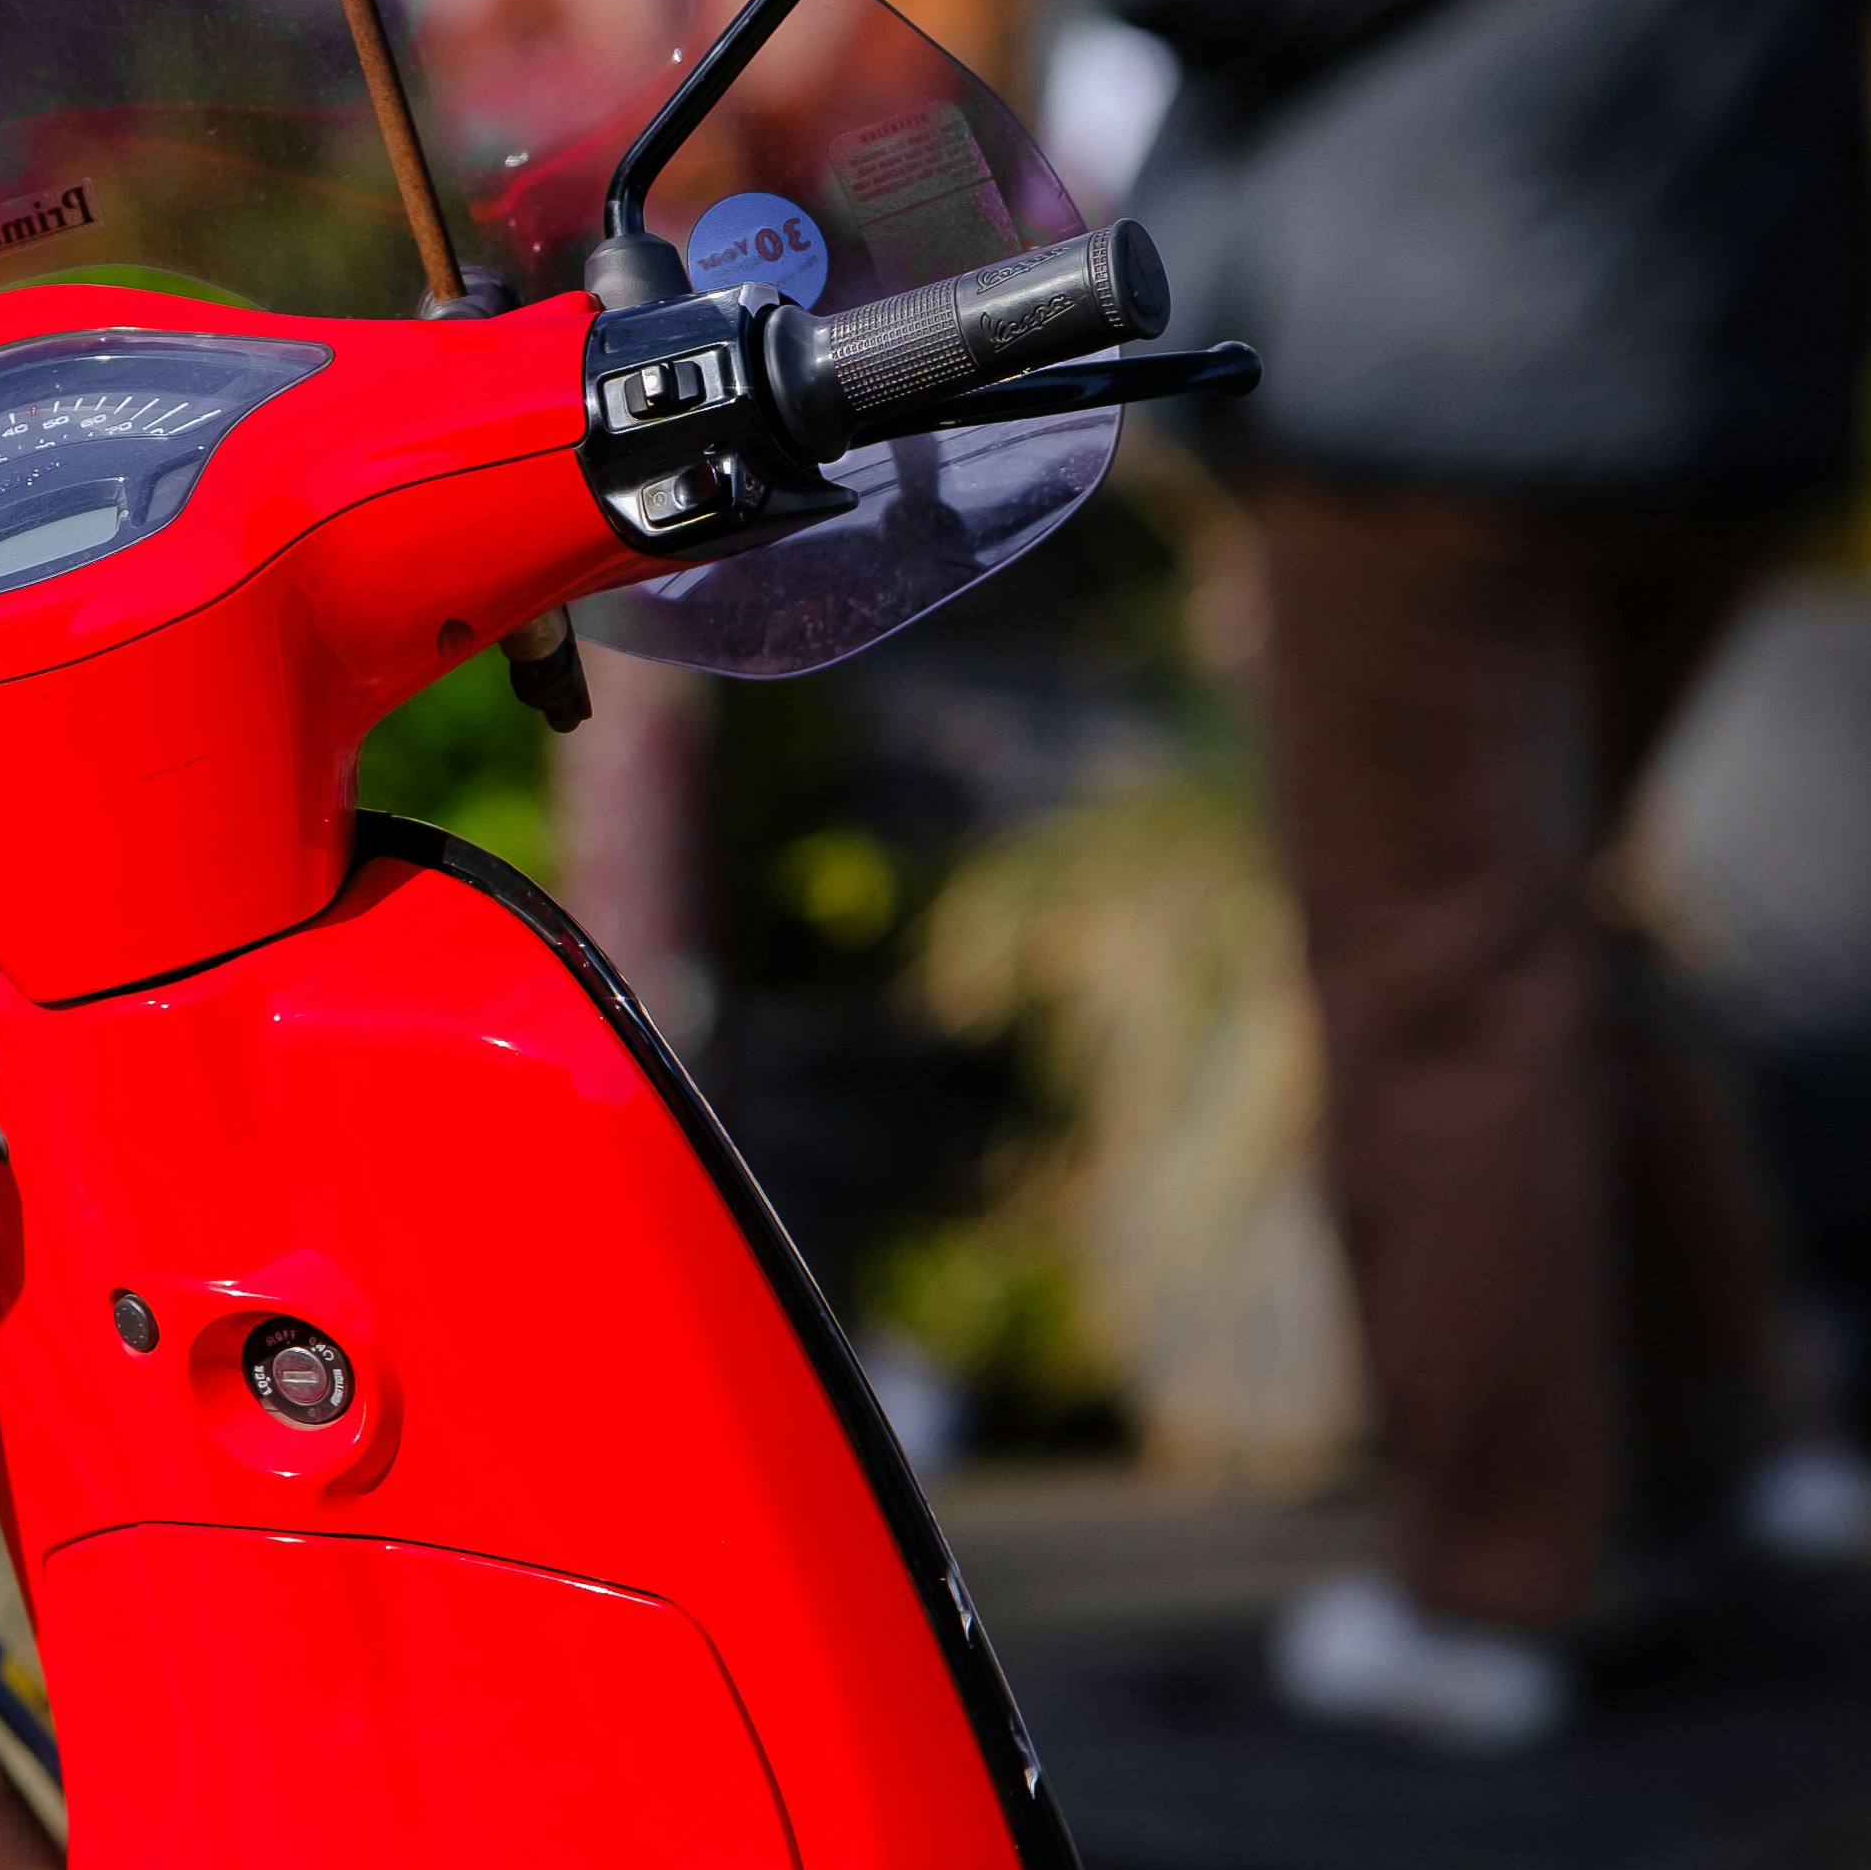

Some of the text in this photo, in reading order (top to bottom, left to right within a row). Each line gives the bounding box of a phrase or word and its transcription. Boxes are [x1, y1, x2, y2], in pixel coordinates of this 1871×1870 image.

[977, 246, 1070, 295] Vespa
[980, 293, 1077, 354] Vespa
[1, 423, 28, 438] 40
[42, 415, 69, 429] 50
[80, 413, 107, 429] 60
[254, 1365, 273, 1396] LOCK
